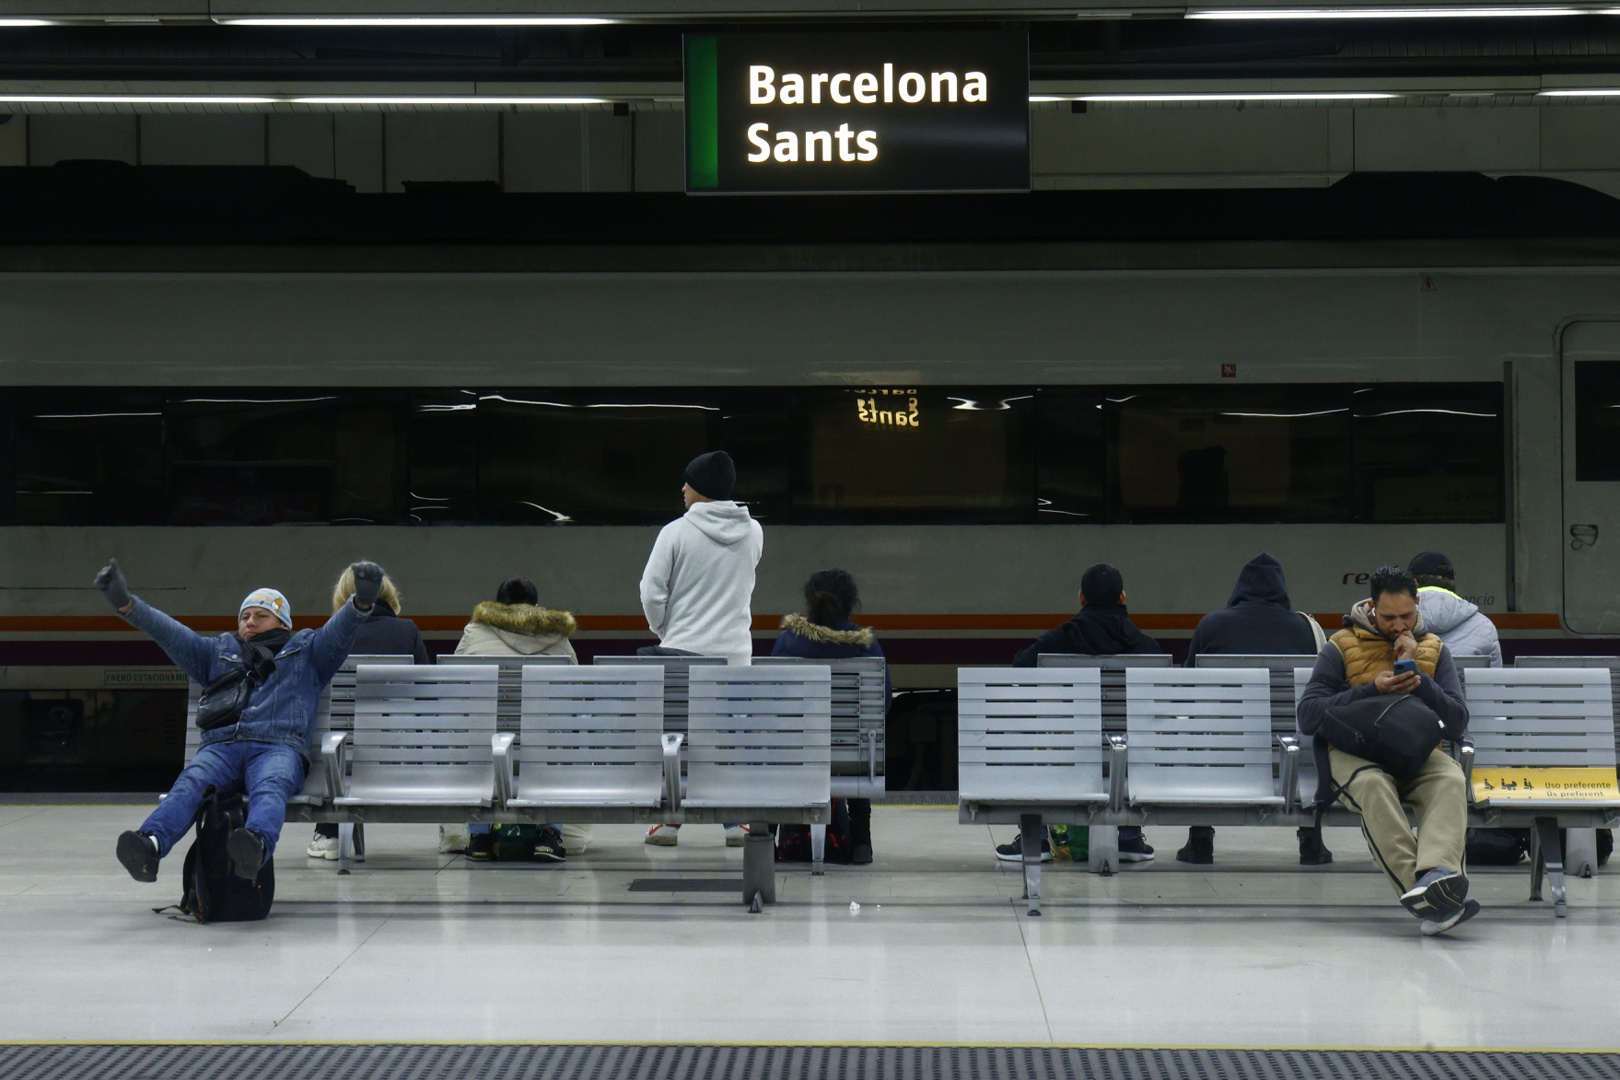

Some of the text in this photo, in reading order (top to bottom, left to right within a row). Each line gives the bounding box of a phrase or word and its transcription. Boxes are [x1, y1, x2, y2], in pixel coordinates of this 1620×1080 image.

[749, 63, 988, 105] Barcelona
[747, 122, 879, 162] Sants
[1342, 572, 1370, 585] re
[106, 673, 188, 682] FRENO ESTACIONAMIE
[1564, 781, 1611, 790] preferente
[1560, 790, 1604, 798] preferent
